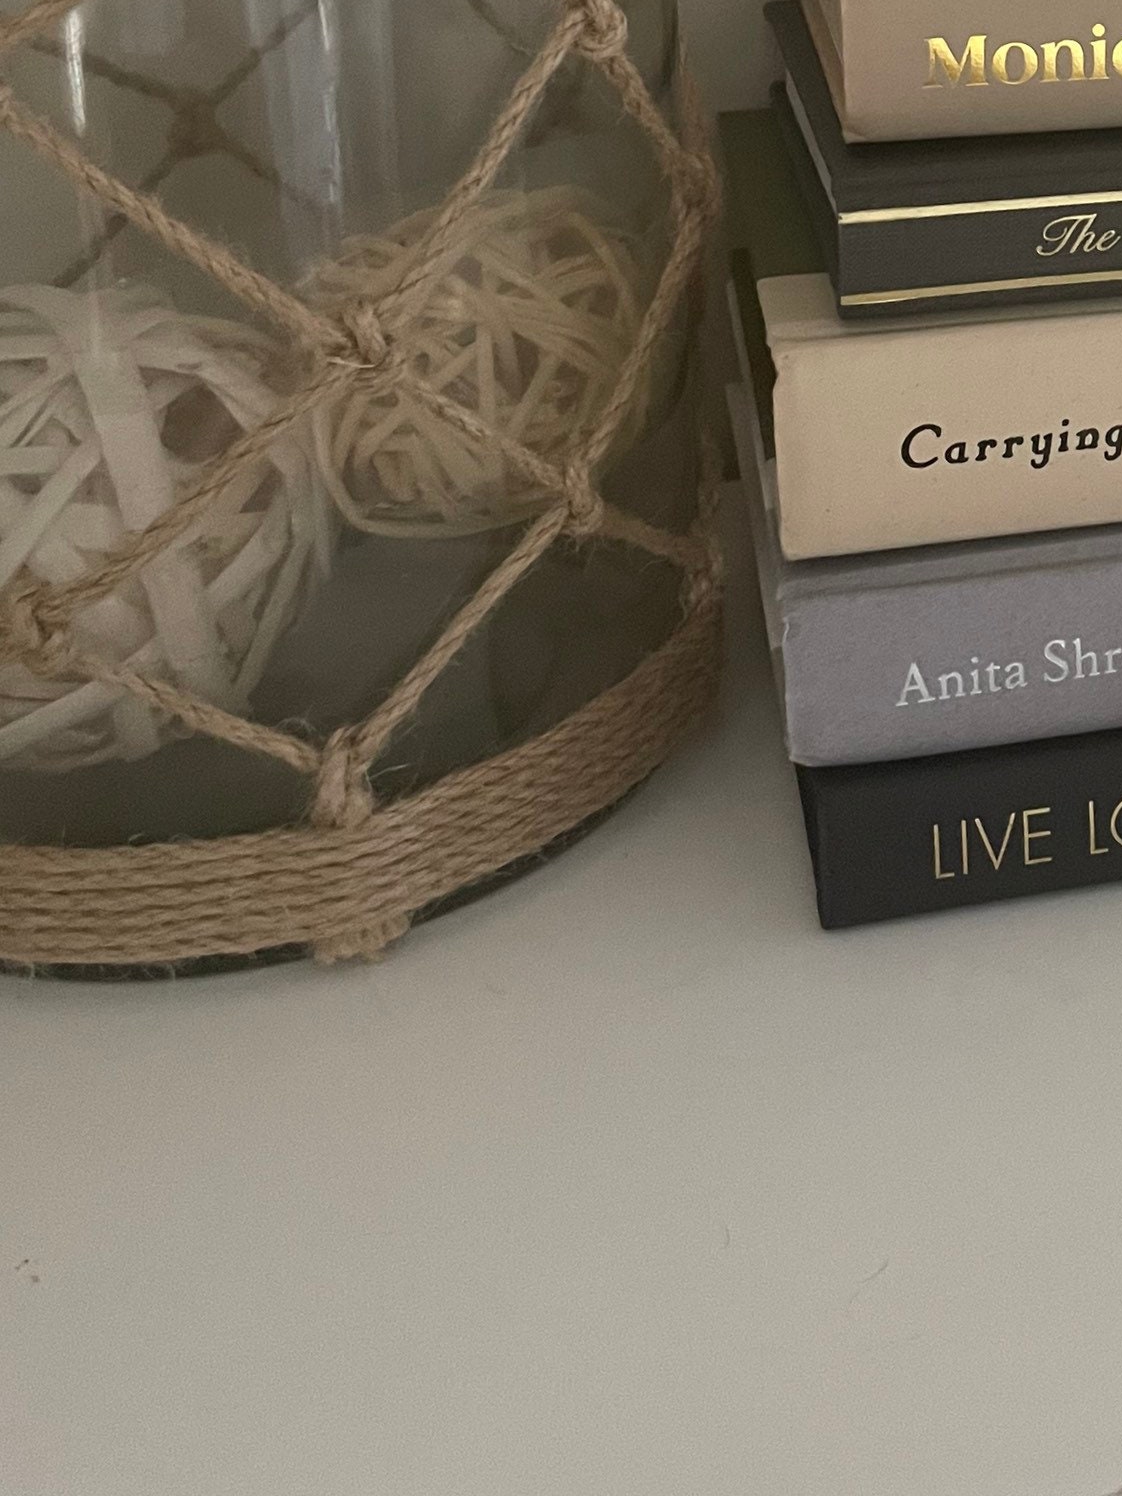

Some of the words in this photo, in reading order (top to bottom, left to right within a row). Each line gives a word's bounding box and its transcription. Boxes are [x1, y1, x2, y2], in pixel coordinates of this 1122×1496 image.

[1036, 213, 1121, 256] The
[896, 657, 1027, 706] Anita
[934, 807, 1052, 879] LIVE
